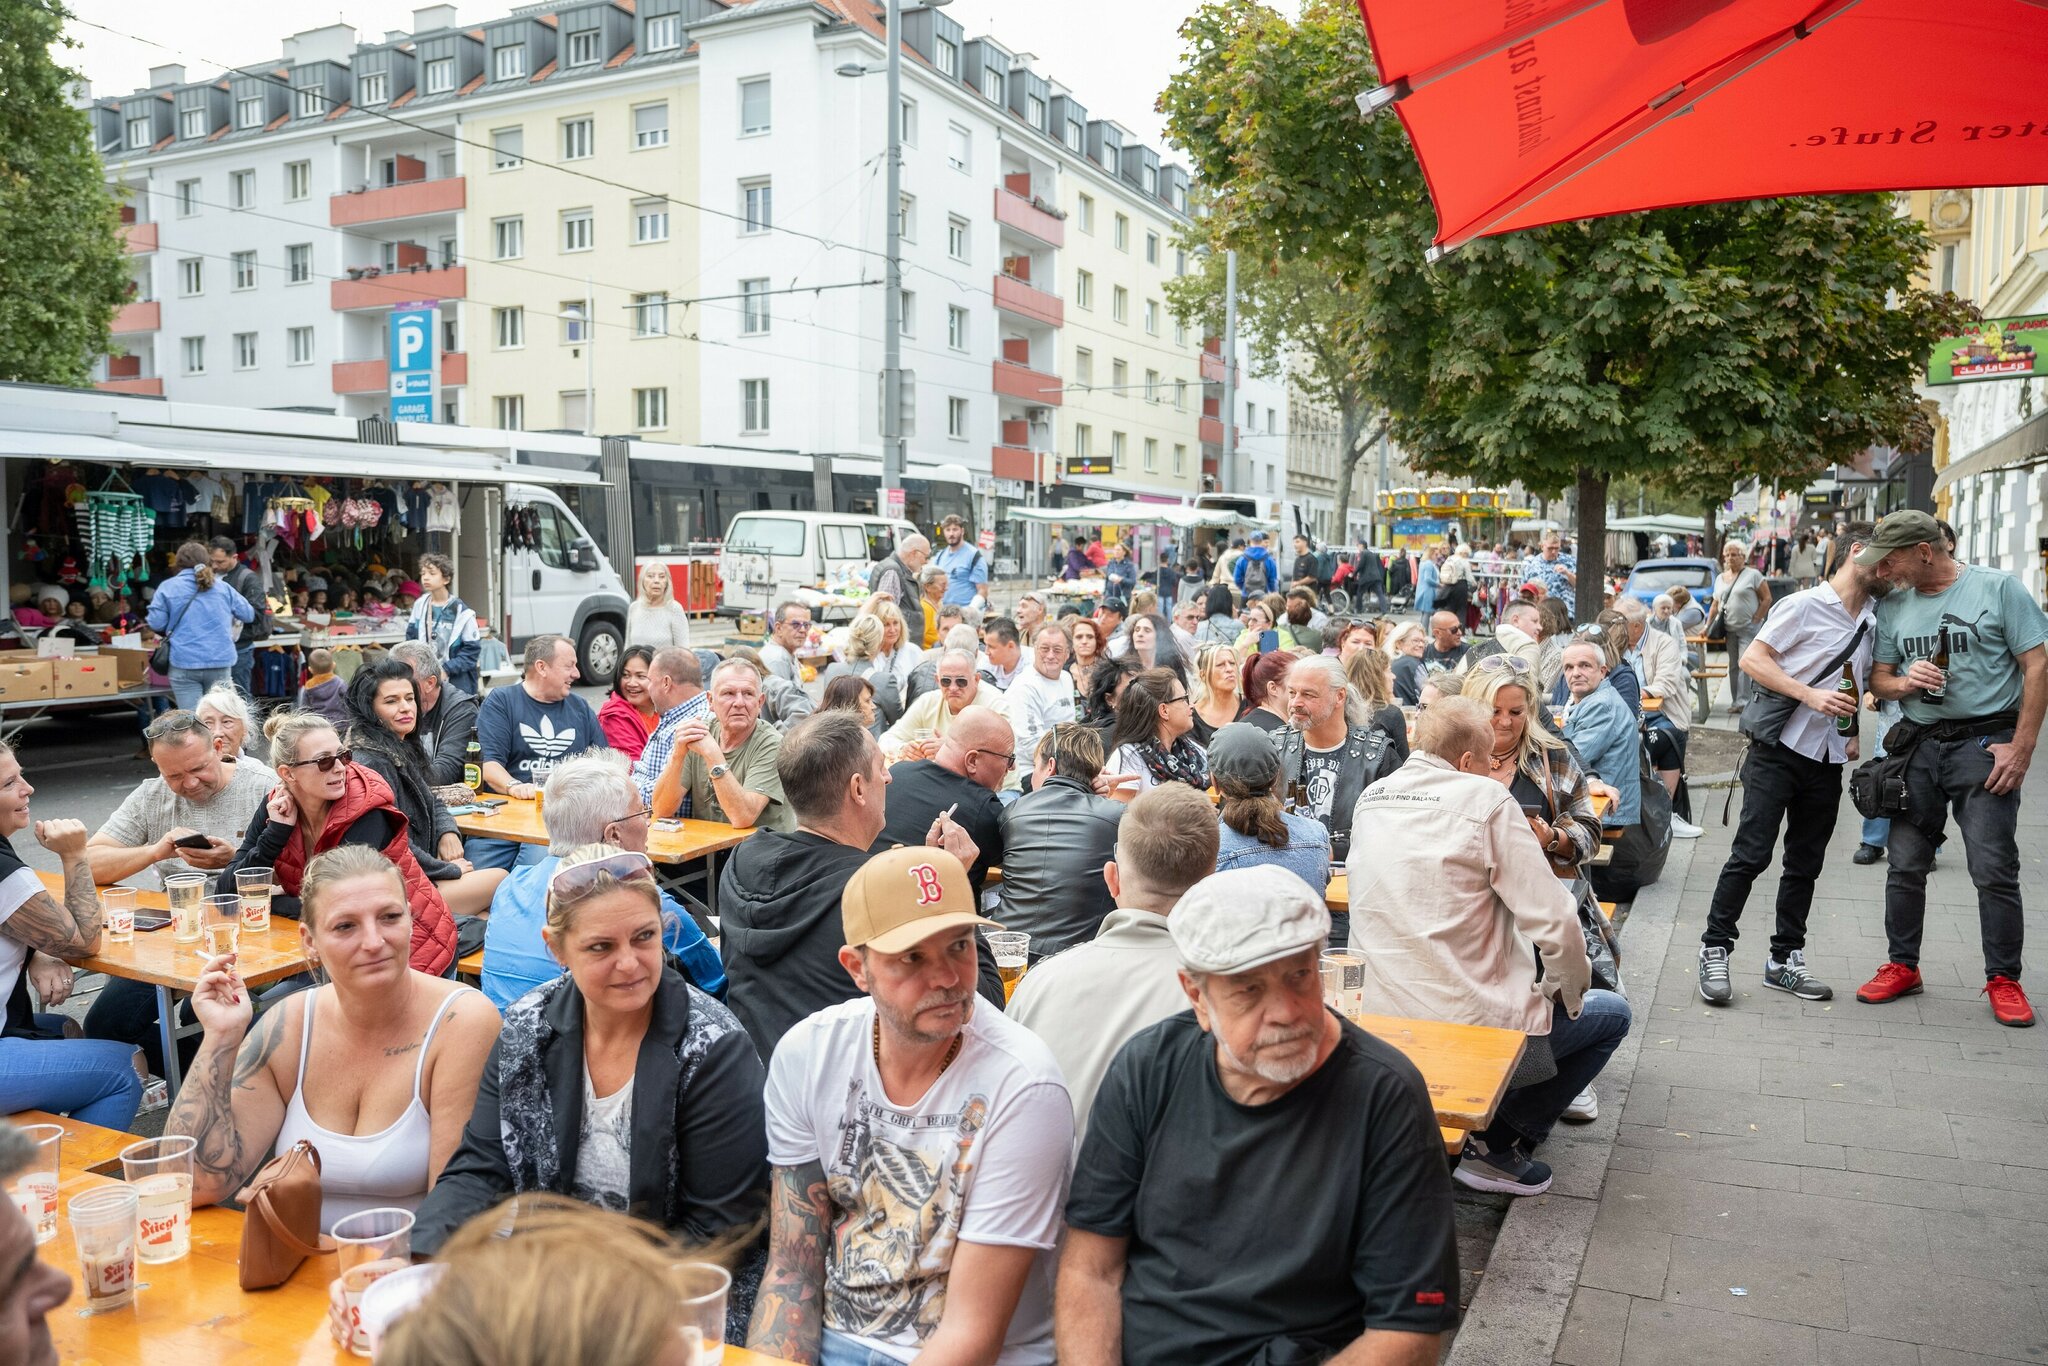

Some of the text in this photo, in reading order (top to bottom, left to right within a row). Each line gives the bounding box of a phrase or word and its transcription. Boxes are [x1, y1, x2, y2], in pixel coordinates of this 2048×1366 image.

[398, 326, 424, 369] P
[397, 404, 426, 414] GARAGE
[519, 757, 554, 772] adid
[1368, 786, 1386, 797] CLUB
[909, 863, 943, 906] B
[140, 1213, 178, 1240] Stiegl
